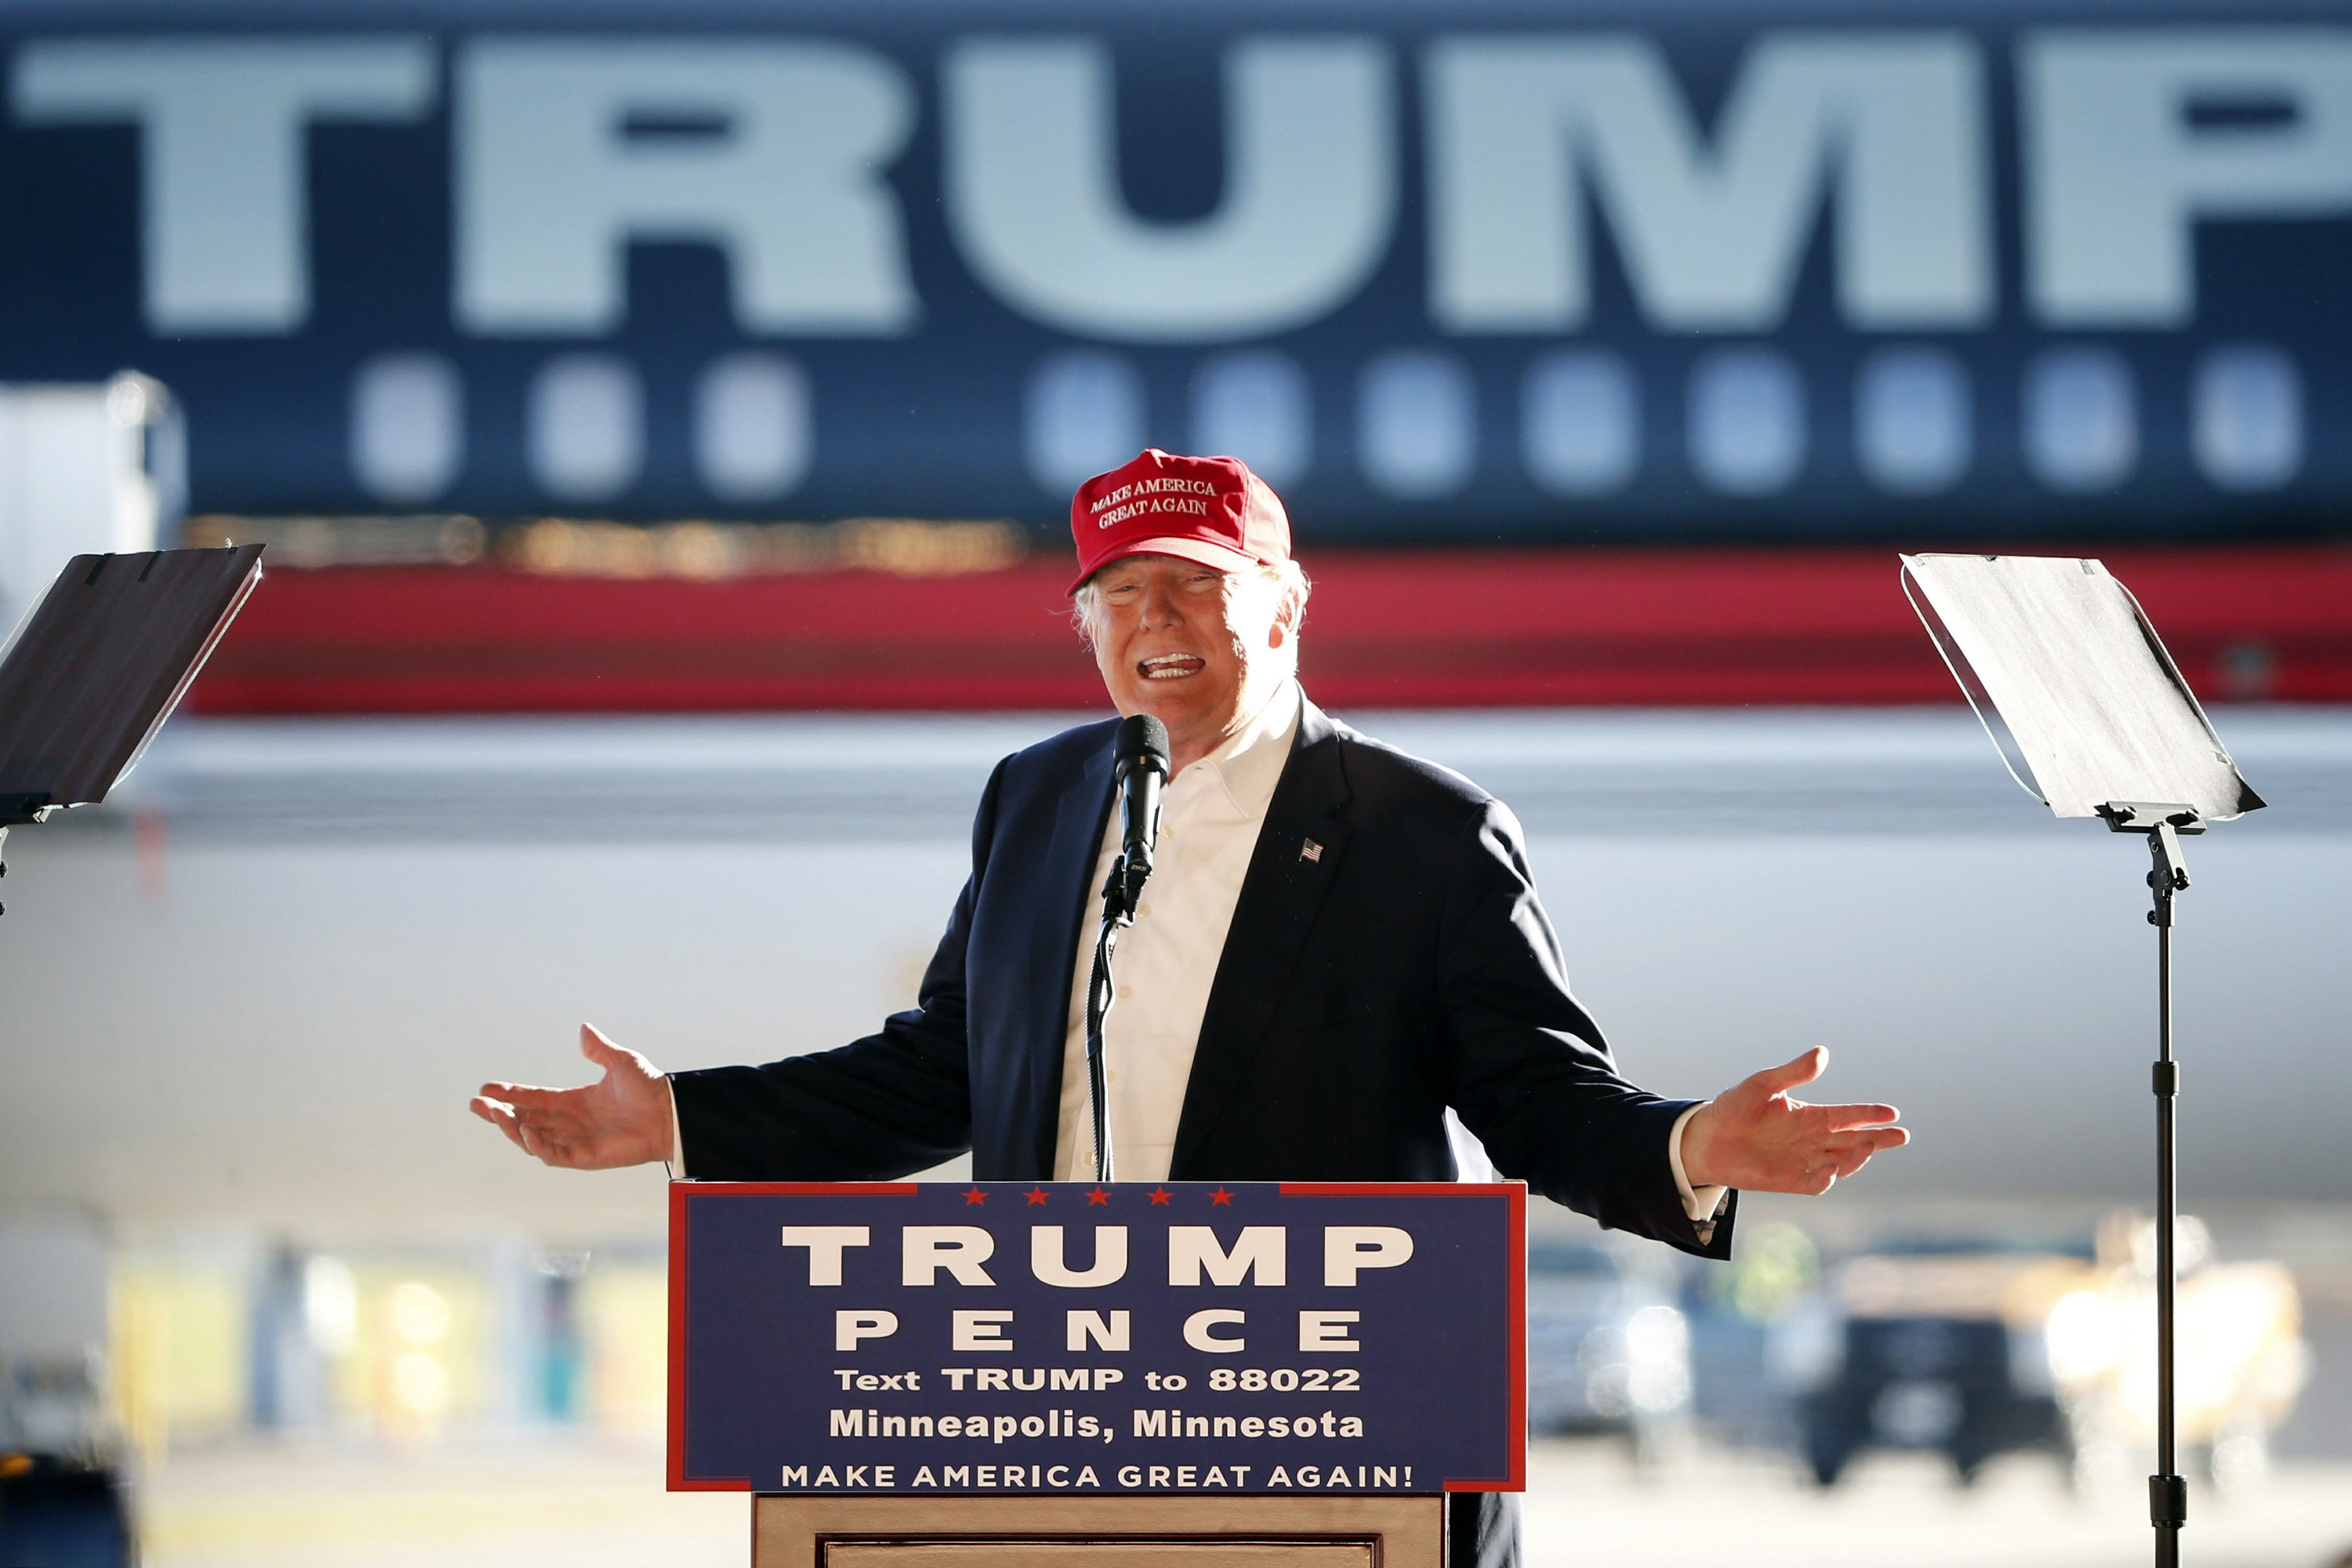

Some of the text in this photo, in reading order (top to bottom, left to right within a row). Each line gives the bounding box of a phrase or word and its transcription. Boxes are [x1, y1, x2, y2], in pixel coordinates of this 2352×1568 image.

[9, 31, 2352, 340] TRUMP
[1089, 477, 1218, 514] MAKE AMERICA
[1098, 497, 1208, 530] GREAT AGAIN
[782, 1225, 1414, 1288] TRUMP
[836, 1308, 1360, 1353] PENCE
[833, 1368, 1360, 1392] Text TRUMP to 88022
[829, 1409, 1363, 1444] Minneapolis, Minnesota
[782, 1465, 1412, 1487] MAKE AMERICA GREAT AGAIN!
